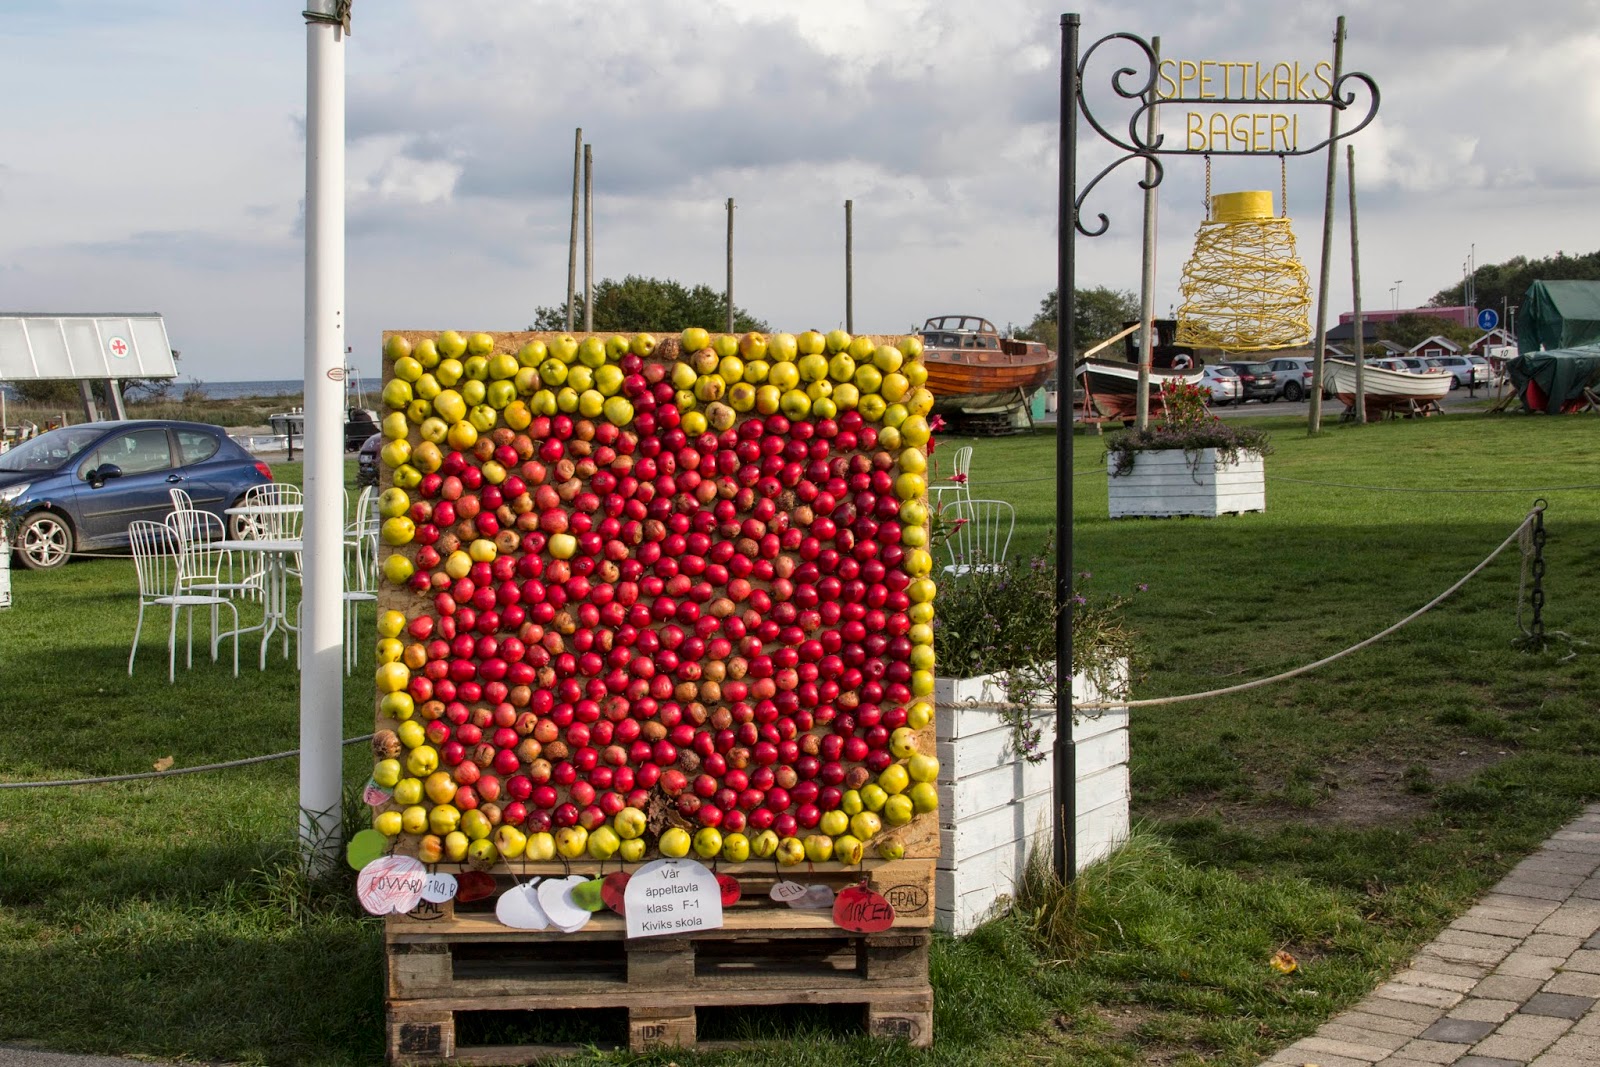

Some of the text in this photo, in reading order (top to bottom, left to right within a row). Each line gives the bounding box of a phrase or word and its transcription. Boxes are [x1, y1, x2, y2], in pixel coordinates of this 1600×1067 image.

[1156, 58, 1333, 100] SPETTKAKS
[1187, 112, 1298, 151] BAGERI
[661, 869, 680, 879] Vår
[645, 883, 699, 898] äppeltavla
[890, 891, 922, 906] EPAL
[646, 899, 700, 914] klass F-1
[641, 917, 703, 931] Kiviks skola
